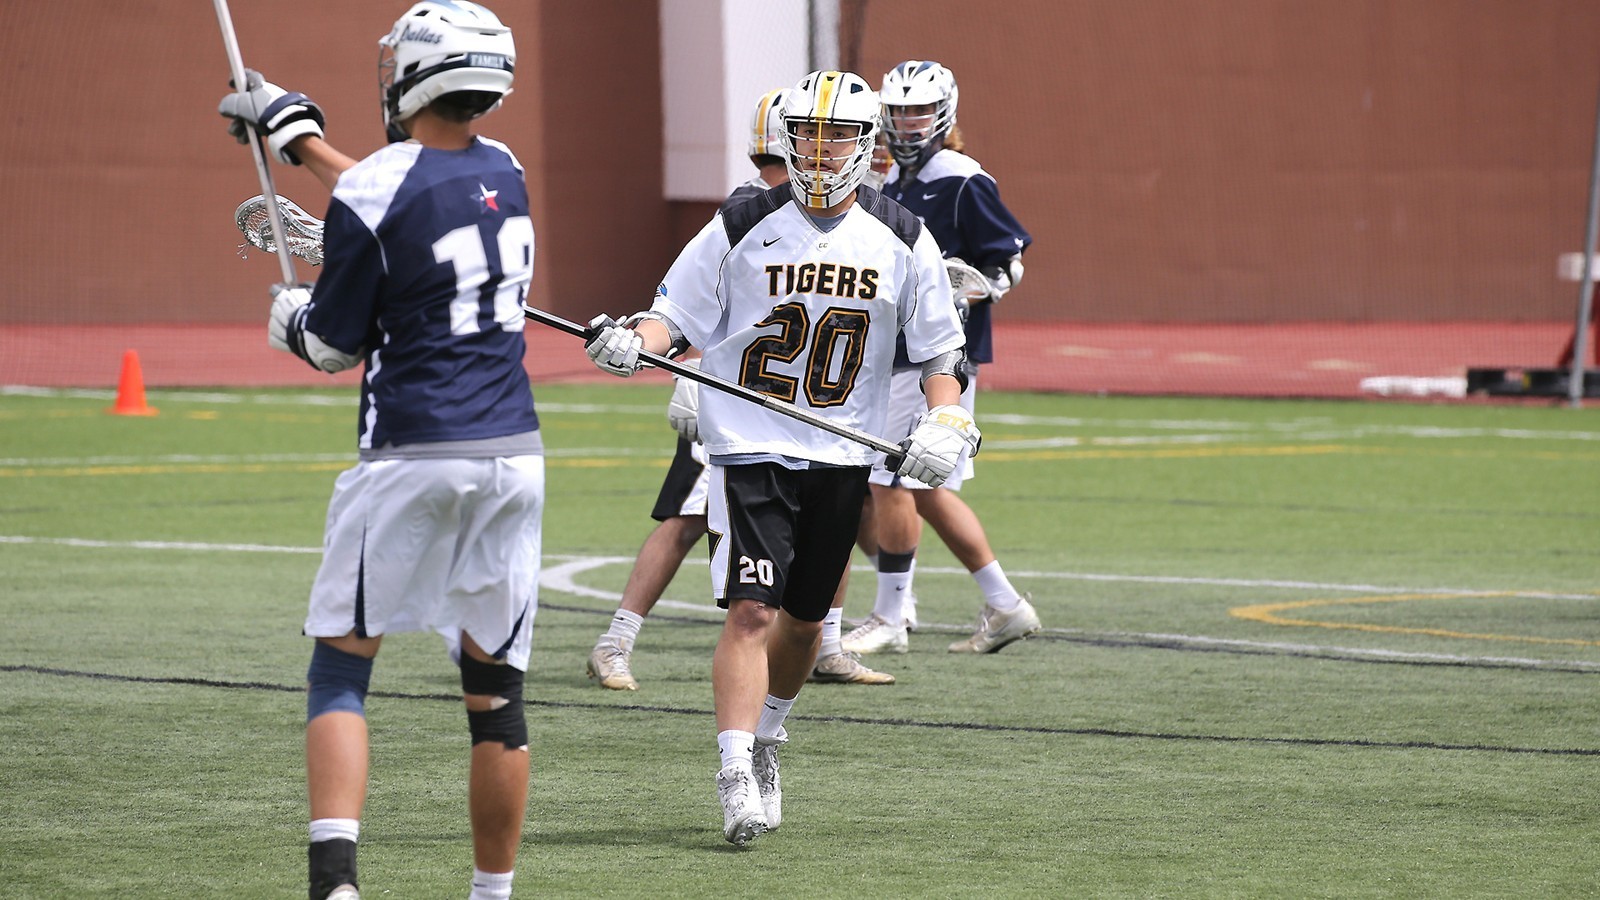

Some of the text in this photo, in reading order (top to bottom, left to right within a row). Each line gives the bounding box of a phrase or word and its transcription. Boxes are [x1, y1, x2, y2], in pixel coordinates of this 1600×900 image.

[470, 54, 504, 69] FAMILY
[431, 215, 535, 336] 18
[764, 262, 879, 300] TIGERS
[738, 302, 871, 408] 20
[936, 412, 972, 434] STX
[739, 555, 774, 587] 20
